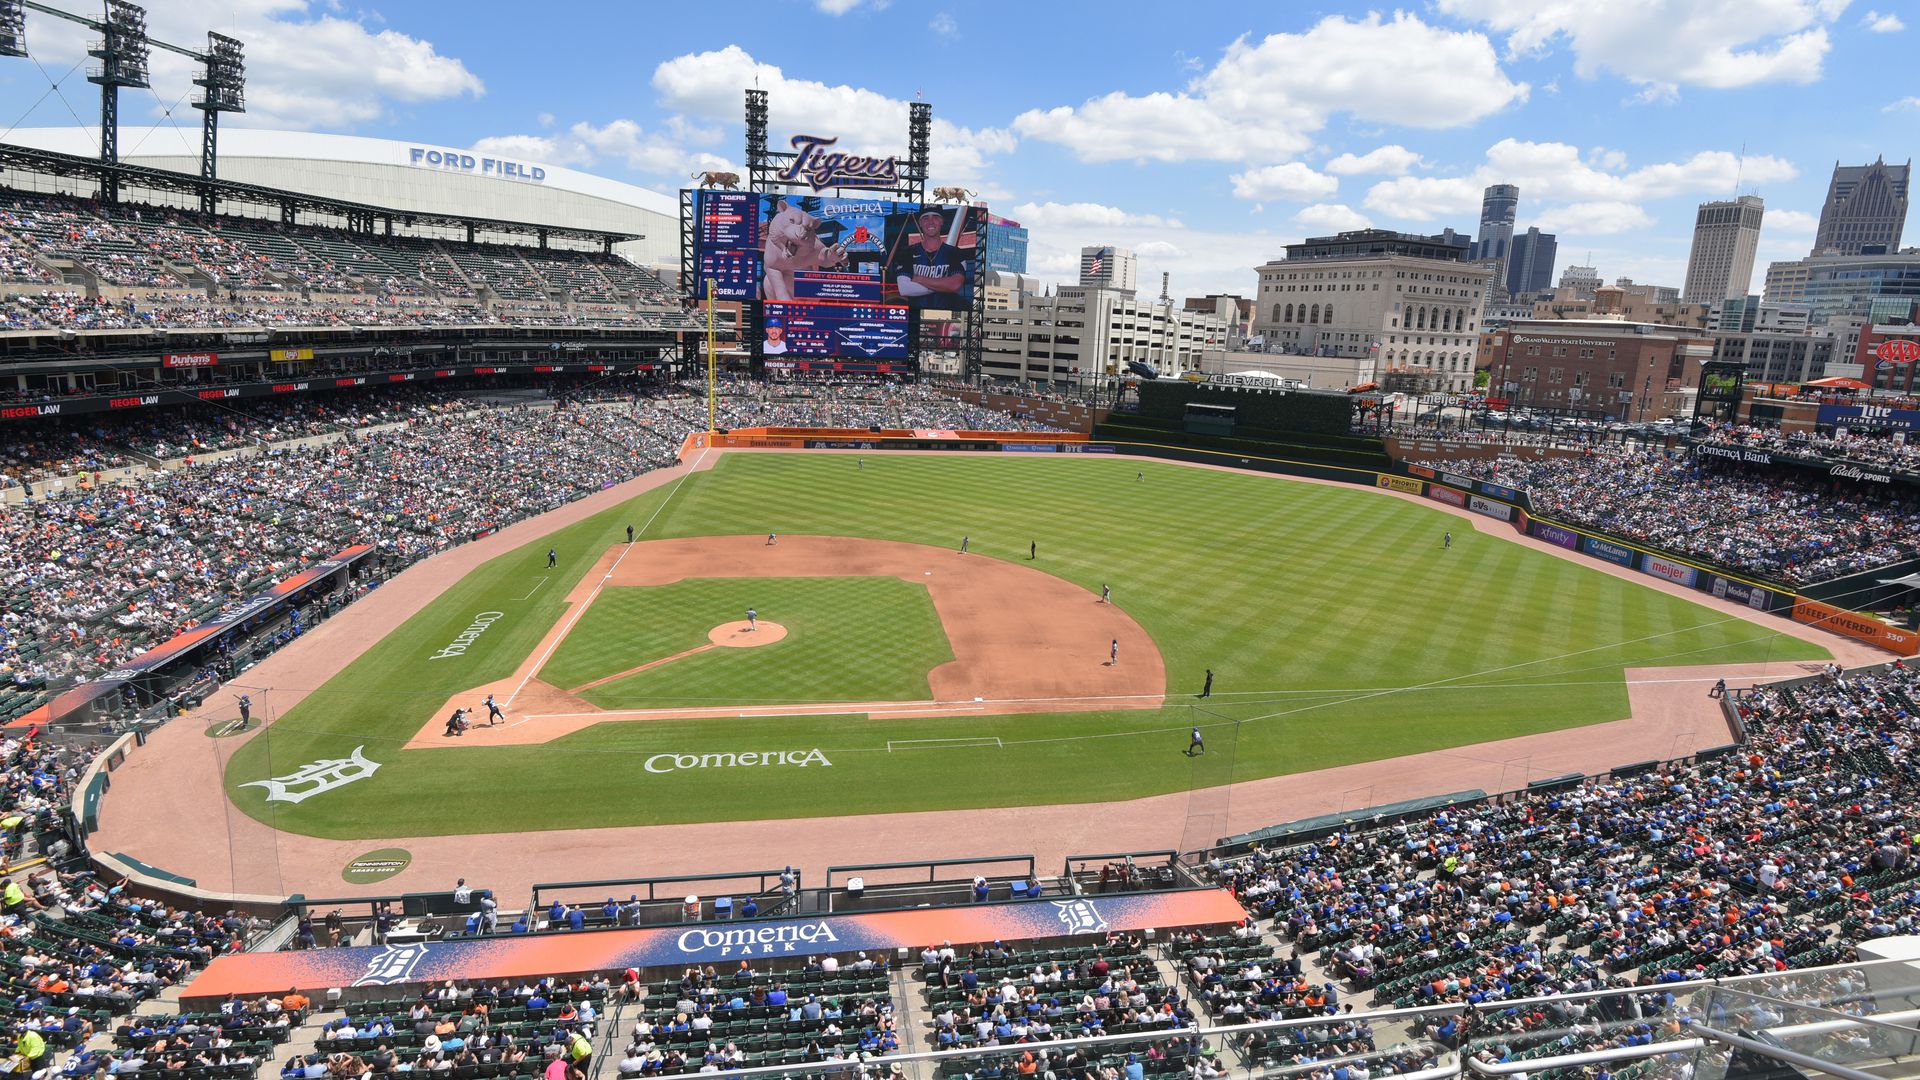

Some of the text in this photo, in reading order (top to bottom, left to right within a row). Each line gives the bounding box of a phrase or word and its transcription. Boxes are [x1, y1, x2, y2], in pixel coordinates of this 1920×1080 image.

[410, 148, 546, 181] FORD FIELD
[778, 135, 899, 192] Tigers
[1579, 338, 1617, 347] UNIVERSITY
[1210, 373, 1303, 390] CHEVROLET
[1196, 384, 1286, 397] FOUNTAIN
[1423, 393, 1460, 407] meijer
[1861, 405, 1892, 419] Lite
[1836, 416, 1887, 426] PITCHER'S
[1065, 444, 1083, 453] DTE
[1744, 451, 1771, 464] Bank
[1830, 464, 1890, 483] Bally SPORTS
[1391, 479, 1419, 489] PRIORITY
[1540, 527, 1570, 544] xfinity
[1599, 543, 1628, 558] McLaren
[1652, 561, 1685, 581] meijer
[1727, 585, 1750, 599] Modelo
[721, 941, 796, 956] PARK
